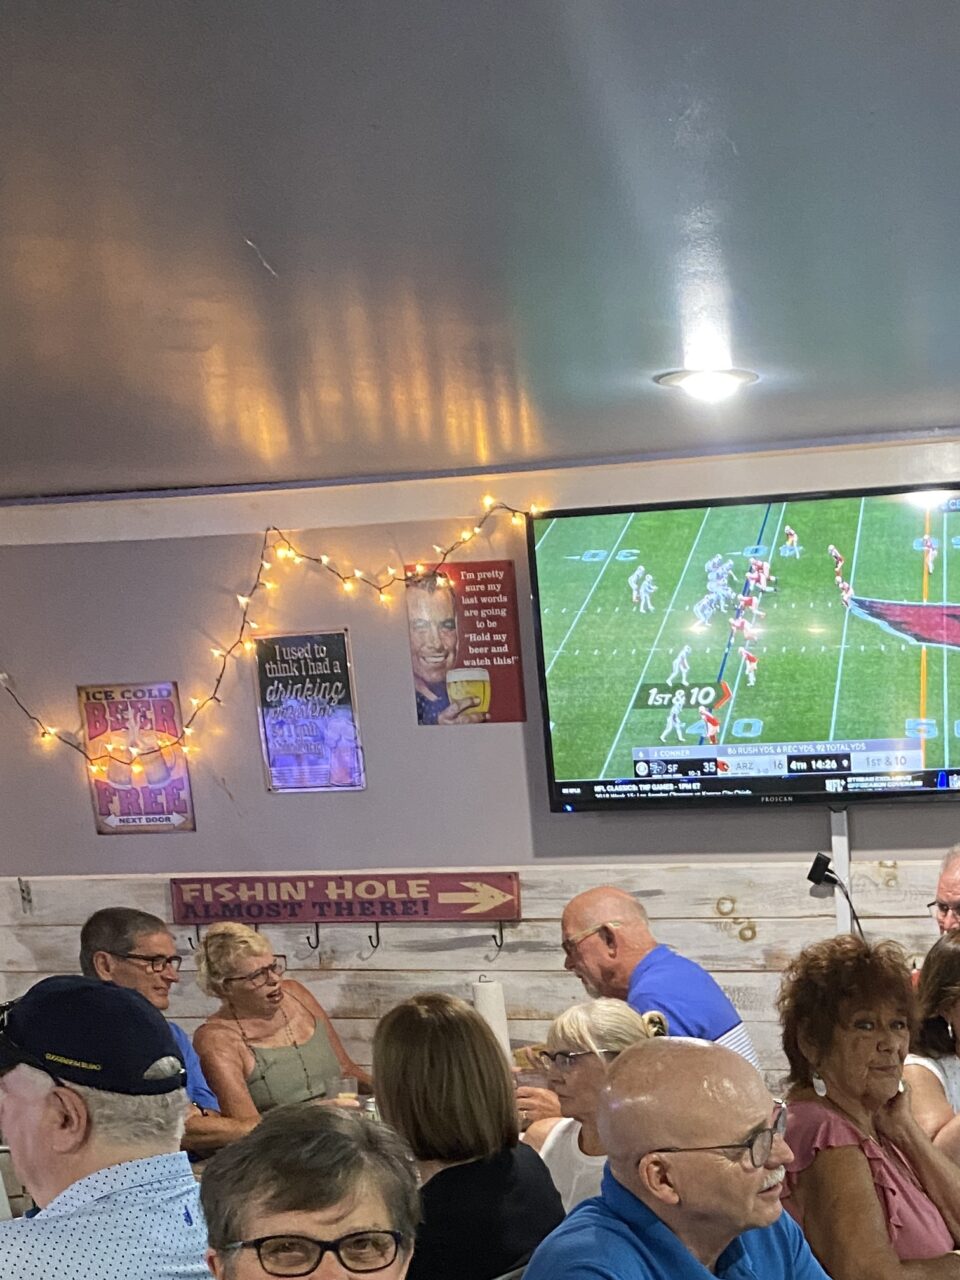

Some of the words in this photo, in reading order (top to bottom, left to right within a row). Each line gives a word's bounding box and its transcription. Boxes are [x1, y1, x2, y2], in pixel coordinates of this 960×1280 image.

[460, 571, 475, 580] I'm
[476, 570, 505, 581] pretty
[465, 584, 485, 592] sure
[487, 583, 502, 592] my
[461, 595, 478, 604] last
[480, 594, 508, 604] words
[464, 609, 479, 617] are
[480, 607, 507, 618] going
[475, 620, 485, 628] to
[486, 619, 497, 628] be
[492, 633, 507, 642] my
[274, 645, 281, 661] I
[282, 642, 313, 660] used
[314, 643, 327, 659] to
[468, 645, 489, 654] beer
[491, 644, 509, 653] and
[265, 659, 300, 678] think
[301, 659, 306, 675] I
[308, 657, 331, 674] had
[333, 660, 342, 673] a
[463, 657, 491, 666] watch
[86, 690, 115, 701] ICE
[120, 688, 172, 700] COLD
[265, 678, 346, 706] drinking
[689, 686, 716, 706] 10
[84, 699, 180, 741] BEER
[738, 746, 758, 755] RUSH
[782, 745, 797, 753] REC
[826, 743, 849, 752] TOTAL
[850, 742, 866, 751] YDS
[667, 763, 678, 773] SF
[703, 762, 716, 773] 35
[735, 762, 754, 771] ARZ
[773, 760, 784, 770] 16
[811, 759, 838, 770] 14:26
[894, 755, 907, 766] 10
[94, 777, 188, 817] FREE
[145, 816, 171, 824] DOOR
[179, 880, 314, 902] FISHIN'
[325, 879, 431, 900] HOLE
[182, 901, 304, 920] ALMOST
[312, 900, 430, 917] THERE!
